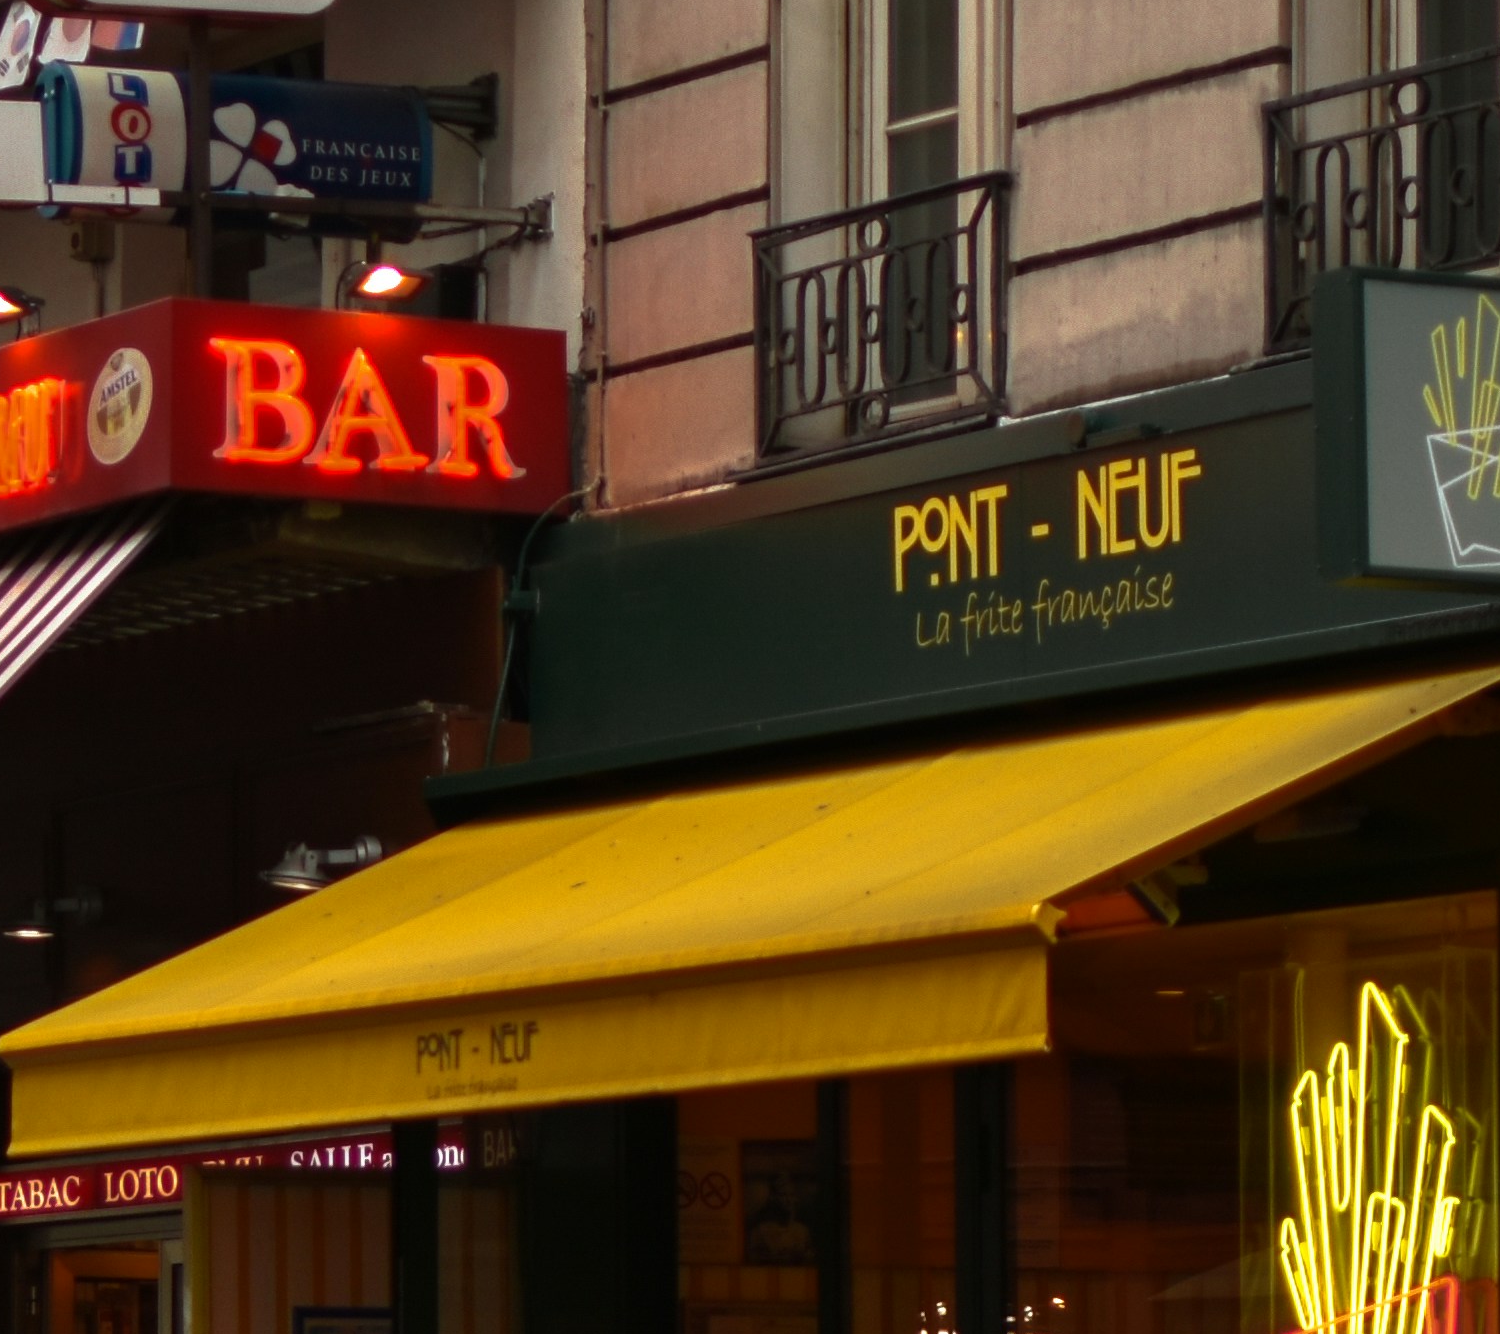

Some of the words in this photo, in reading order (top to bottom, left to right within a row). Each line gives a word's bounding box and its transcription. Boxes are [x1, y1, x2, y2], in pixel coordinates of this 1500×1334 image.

[310, 164, 350, 183] DES
[359, 168, 413, 187] JEUX
[99, 369, 139, 408] AMSTEL
[209, 336, 527, 478] BAR
[893, 484, 1008, 593] PONT
[1076, 448, 1202, 560] NEUF
[915, 611, 952, 647] La
[959, 590, 1025, 657] frite
[1031, 565, 1174, 645] française
[415, 1027, 464, 1075] PONT
[489, 1020, 540, 1065] NEUF
[103, 1164, 180, 1204] LOTO
